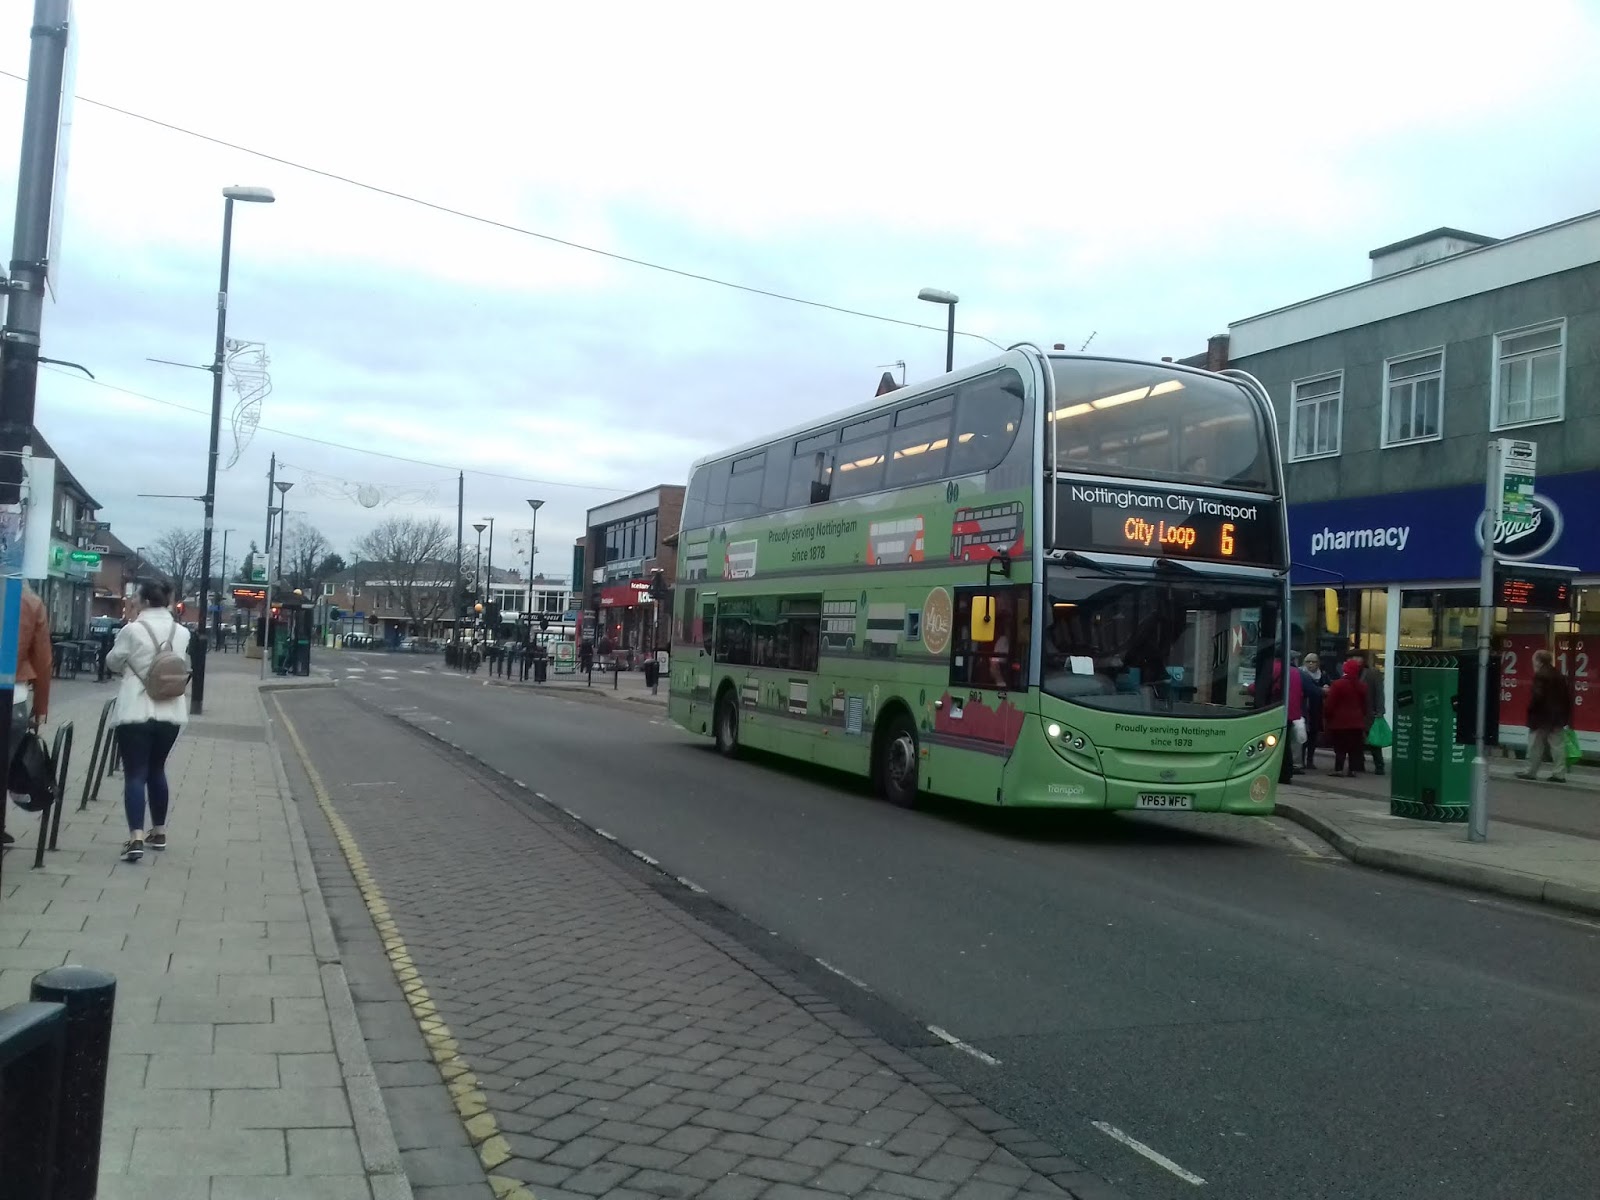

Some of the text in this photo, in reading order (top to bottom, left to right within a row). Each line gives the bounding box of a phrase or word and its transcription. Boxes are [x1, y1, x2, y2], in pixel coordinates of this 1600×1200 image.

[1071, 486, 1257, 521] Nottingham City Transport
[768, 518, 857, 544] Proudly serving Nottingham
[1124, 517, 1235, 556] City Loop 6
[1311, 526, 1410, 556] pharmacy
[792, 545, 826, 562] since 1878
[1114, 723, 1226, 737] Proudly serving Nottingham
[1150, 738, 1193, 747] since 1878
[1141, 795, 1187, 807] YP63 WFC
